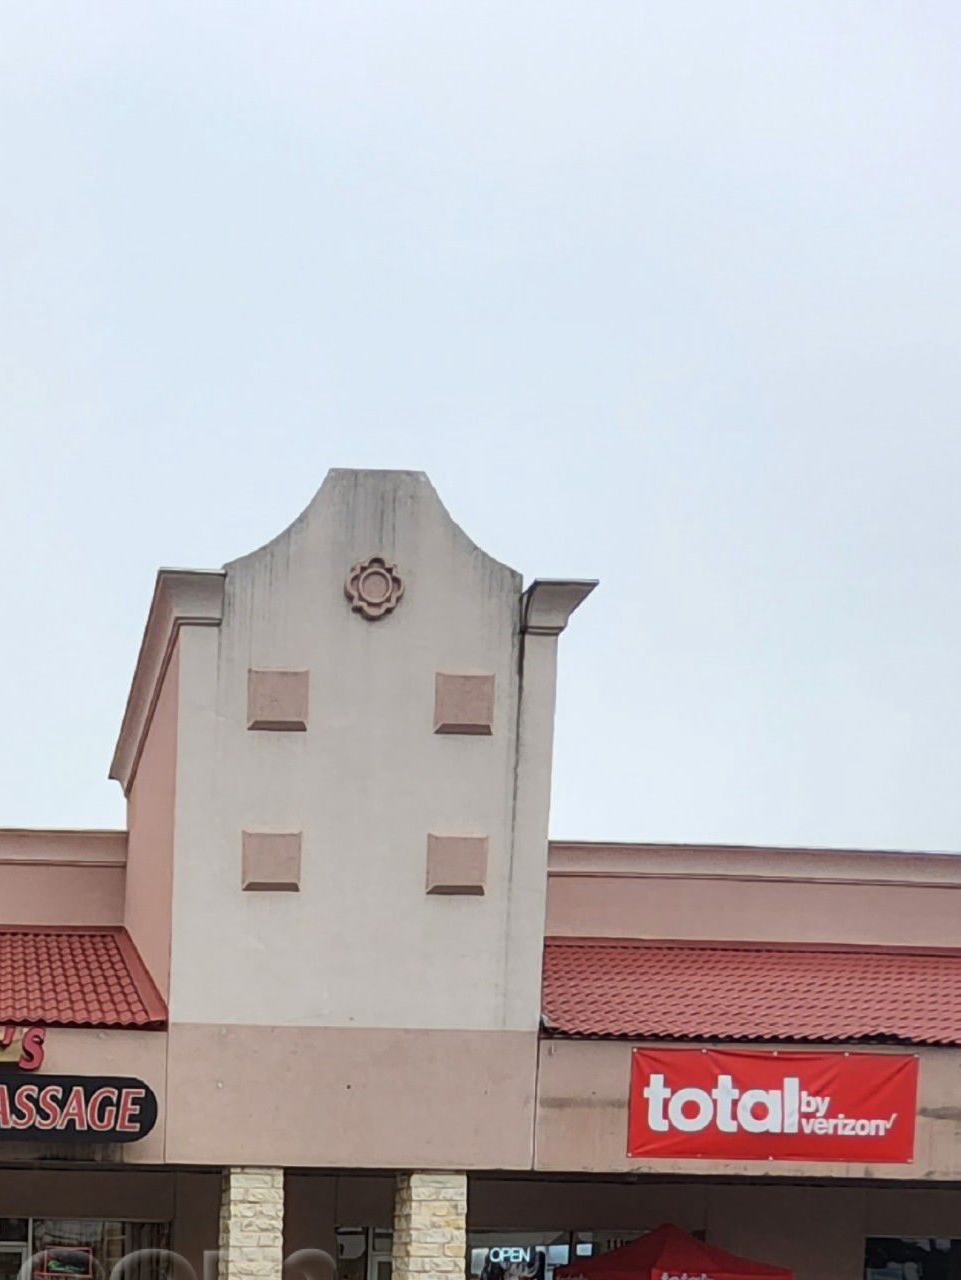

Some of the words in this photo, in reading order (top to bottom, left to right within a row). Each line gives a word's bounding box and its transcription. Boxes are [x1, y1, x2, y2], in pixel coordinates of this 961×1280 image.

[643, 1073, 800, 1134] total
[800, 1090, 831, 1114] by
[801, 1114, 888, 1137] verizon
[489, 1247, 531, 1263] OPEN
